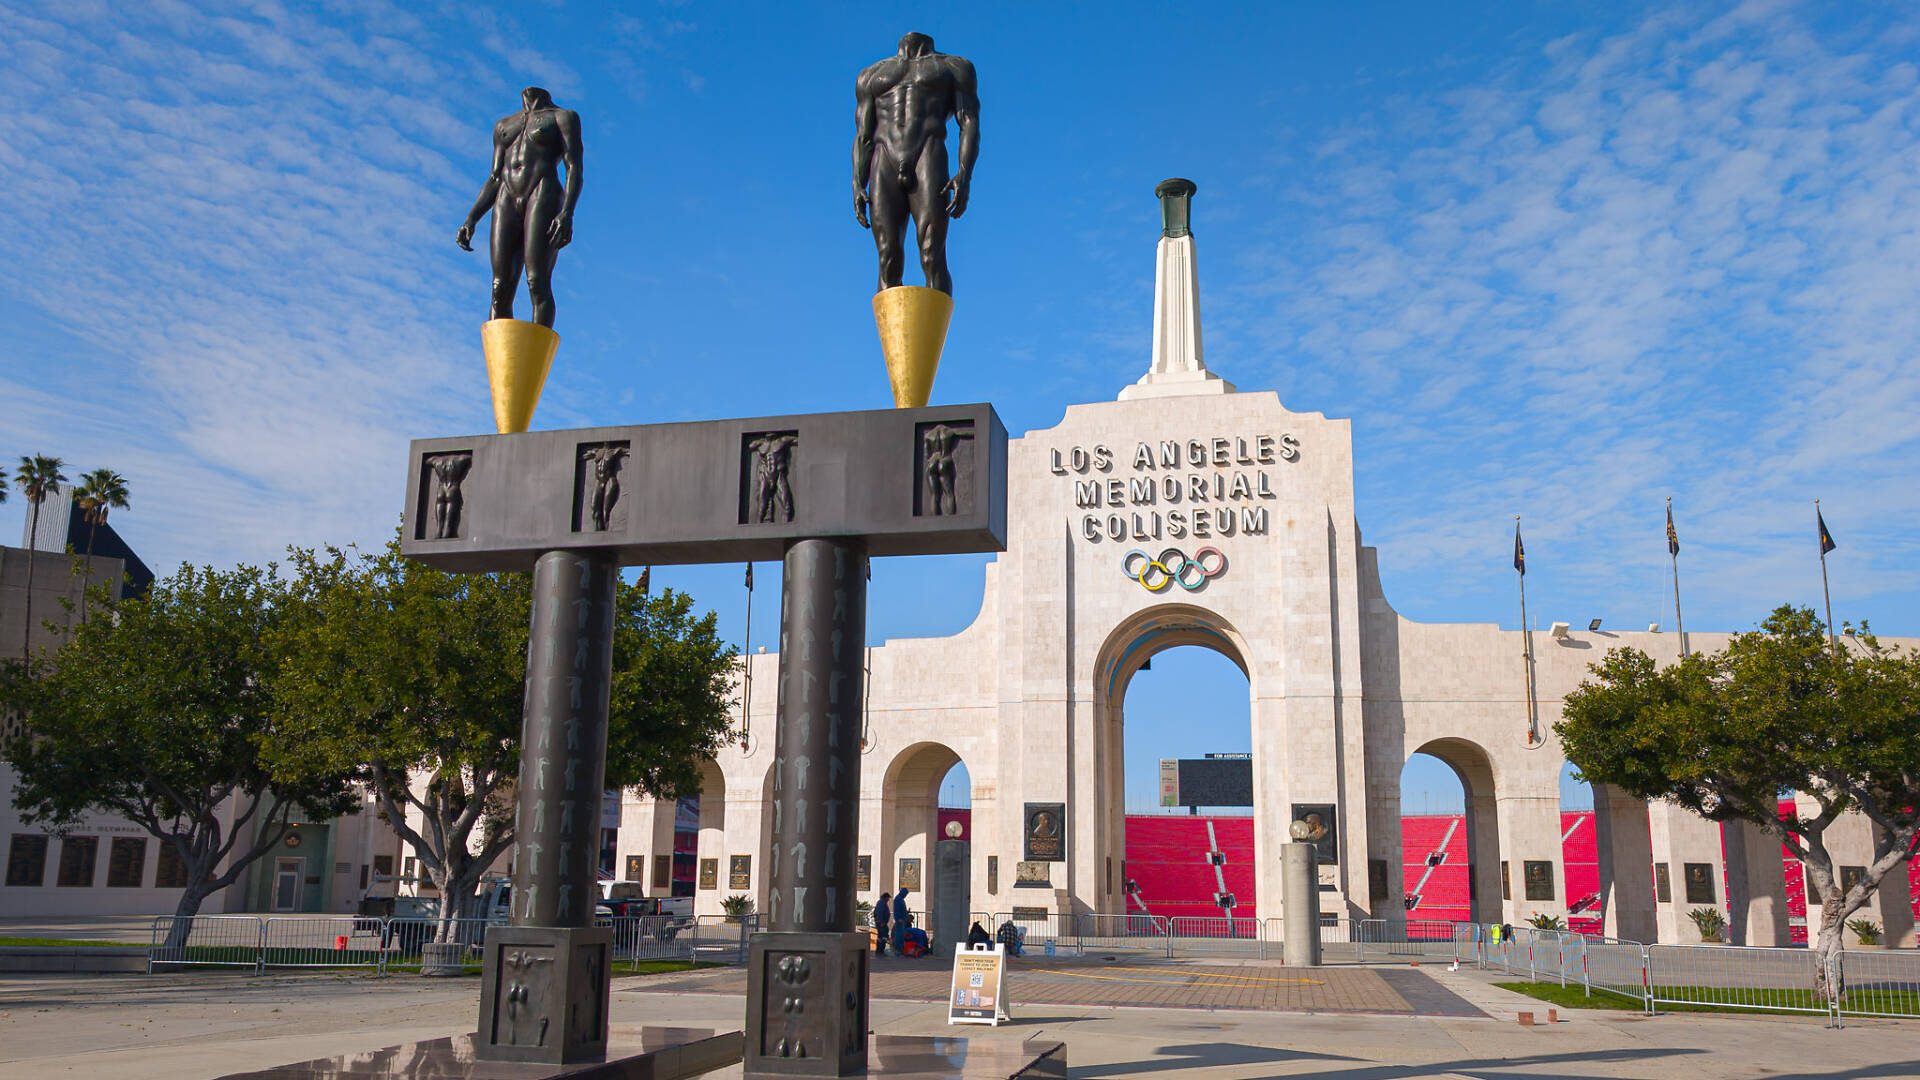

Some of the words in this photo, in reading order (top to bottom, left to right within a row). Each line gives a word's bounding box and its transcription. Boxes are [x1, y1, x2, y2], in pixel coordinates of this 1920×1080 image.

[1051, 445, 1111, 474] LOS
[1133, 433, 1300, 469] ANGELES
[1075, 470, 1273, 506] MEMORIAL
[1082, 505, 1266, 540] COLISEUM
